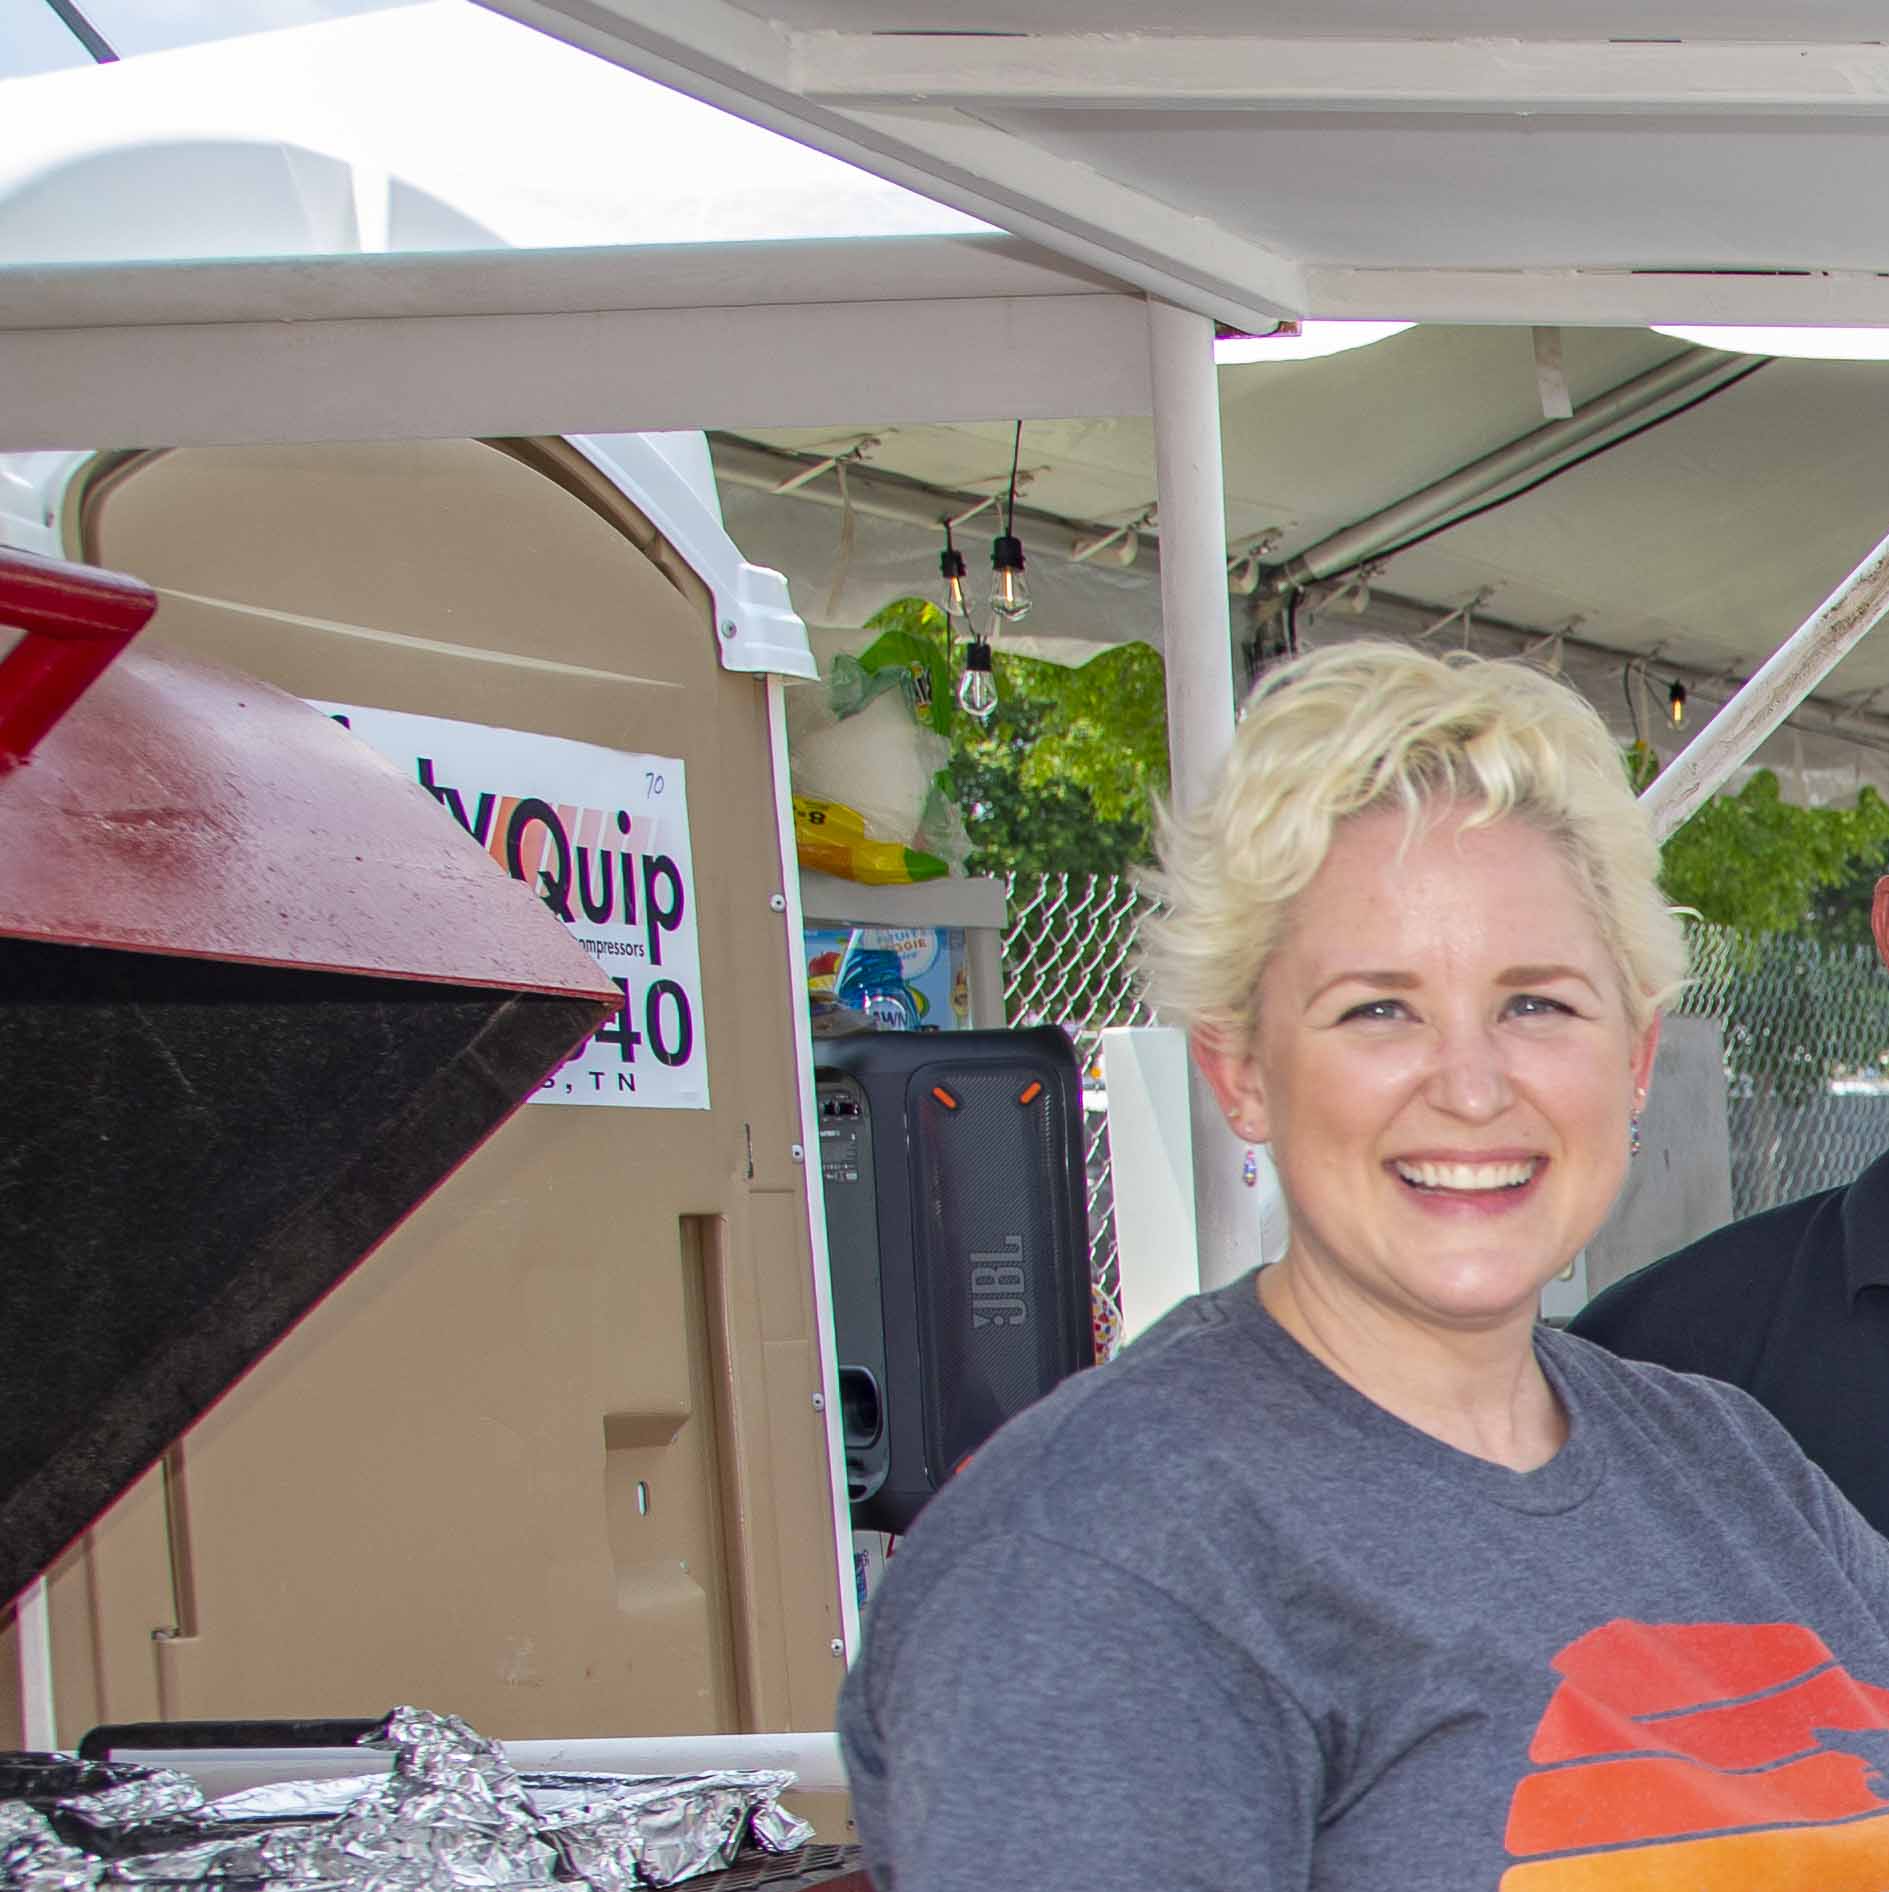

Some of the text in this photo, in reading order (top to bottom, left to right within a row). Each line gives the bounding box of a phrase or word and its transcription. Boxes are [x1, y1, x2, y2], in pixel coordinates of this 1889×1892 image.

[645, 772, 665, 799] 70
[577, 938, 645, 959] ompressors
[589, 1072, 636, 1092] TN
[970, 1234, 1028, 1328] JBL
